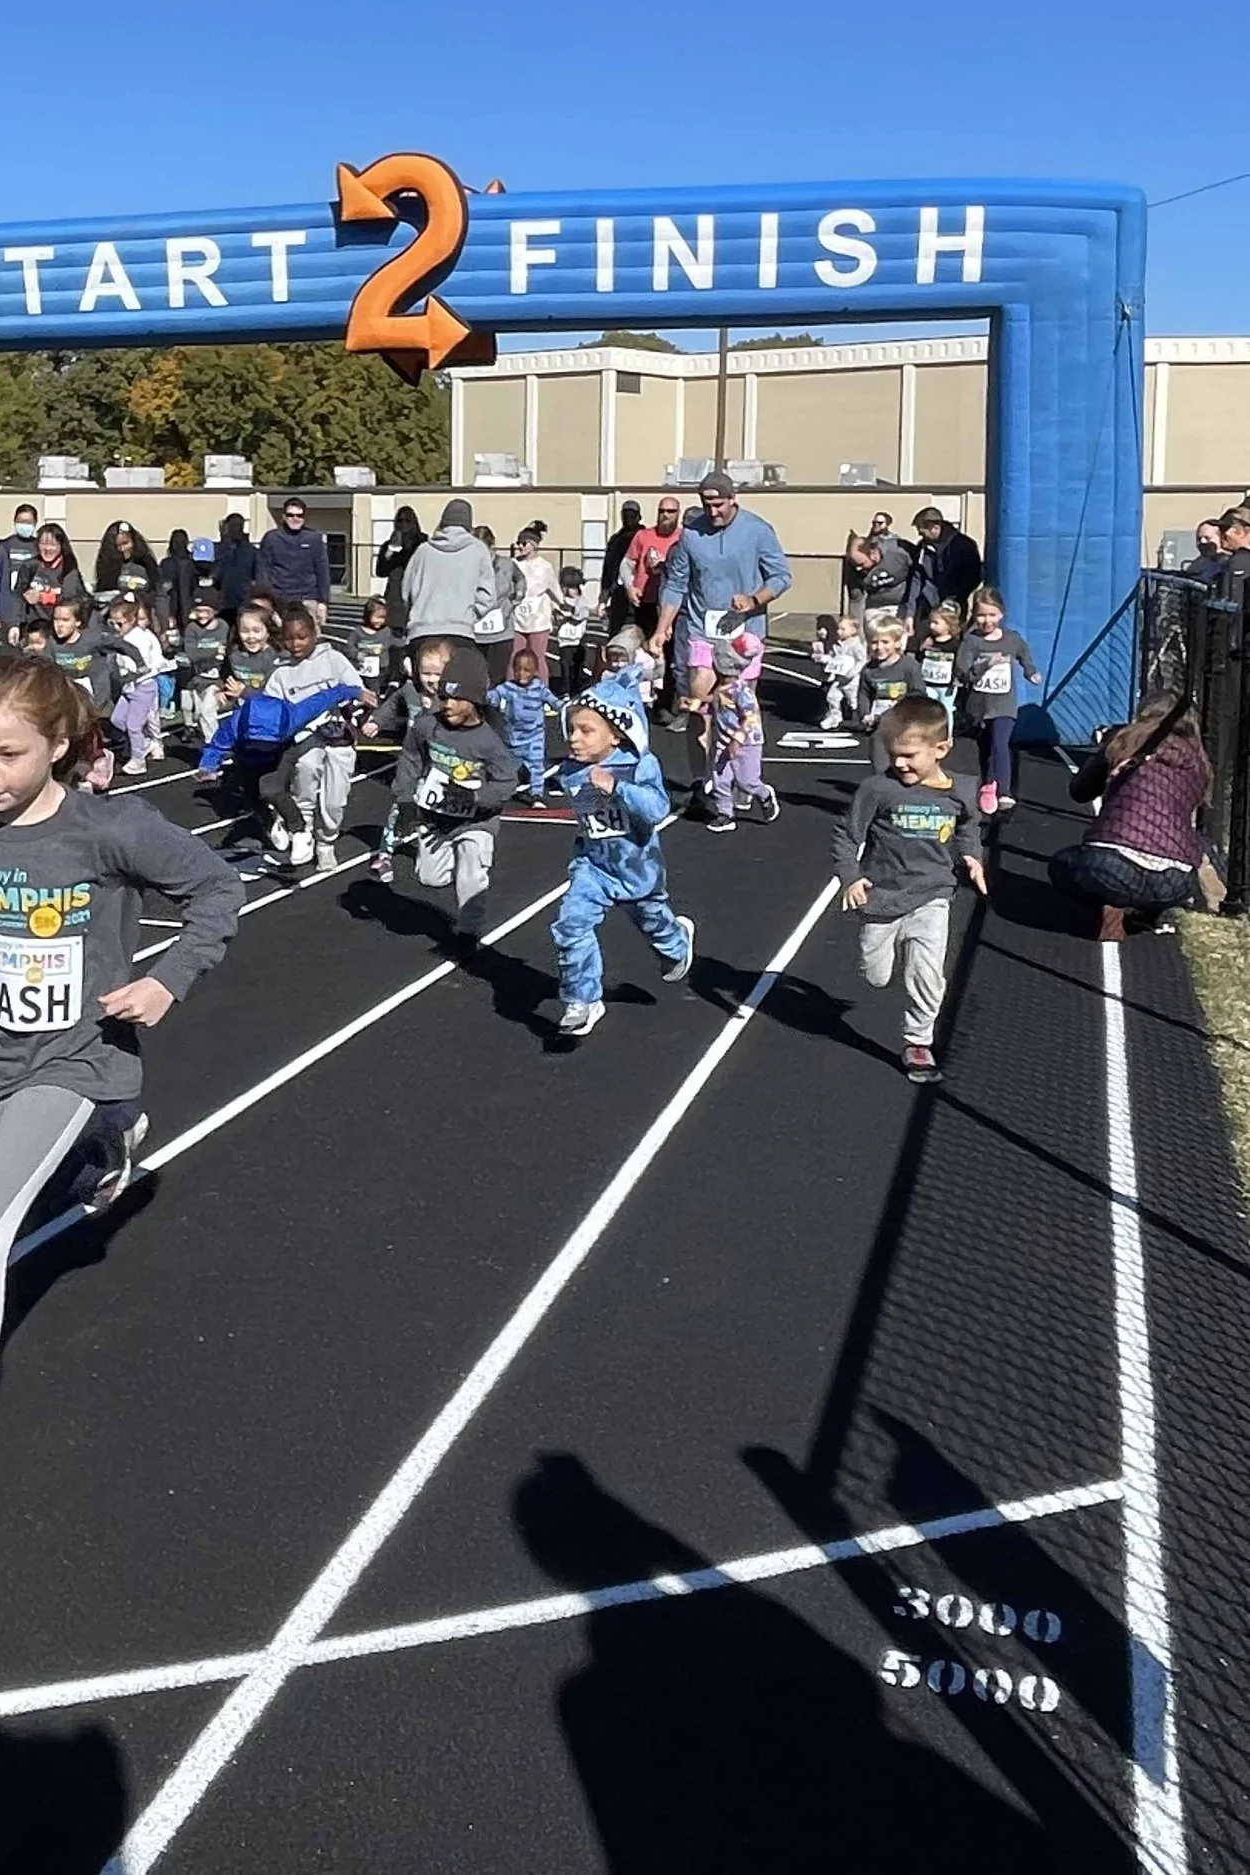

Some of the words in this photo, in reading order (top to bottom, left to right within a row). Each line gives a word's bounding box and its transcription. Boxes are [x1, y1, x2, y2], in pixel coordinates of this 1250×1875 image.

[337, 152, 470, 370] 2
[509, 205, 985, 294] FINISH
[975, 678, 1007, 690] DASH
[586, 810, 624, 833] ASH
[13, 867, 28, 883] in
[893, 1585, 1062, 1643] 3000
[878, 1649, 1061, 1712] 5000
